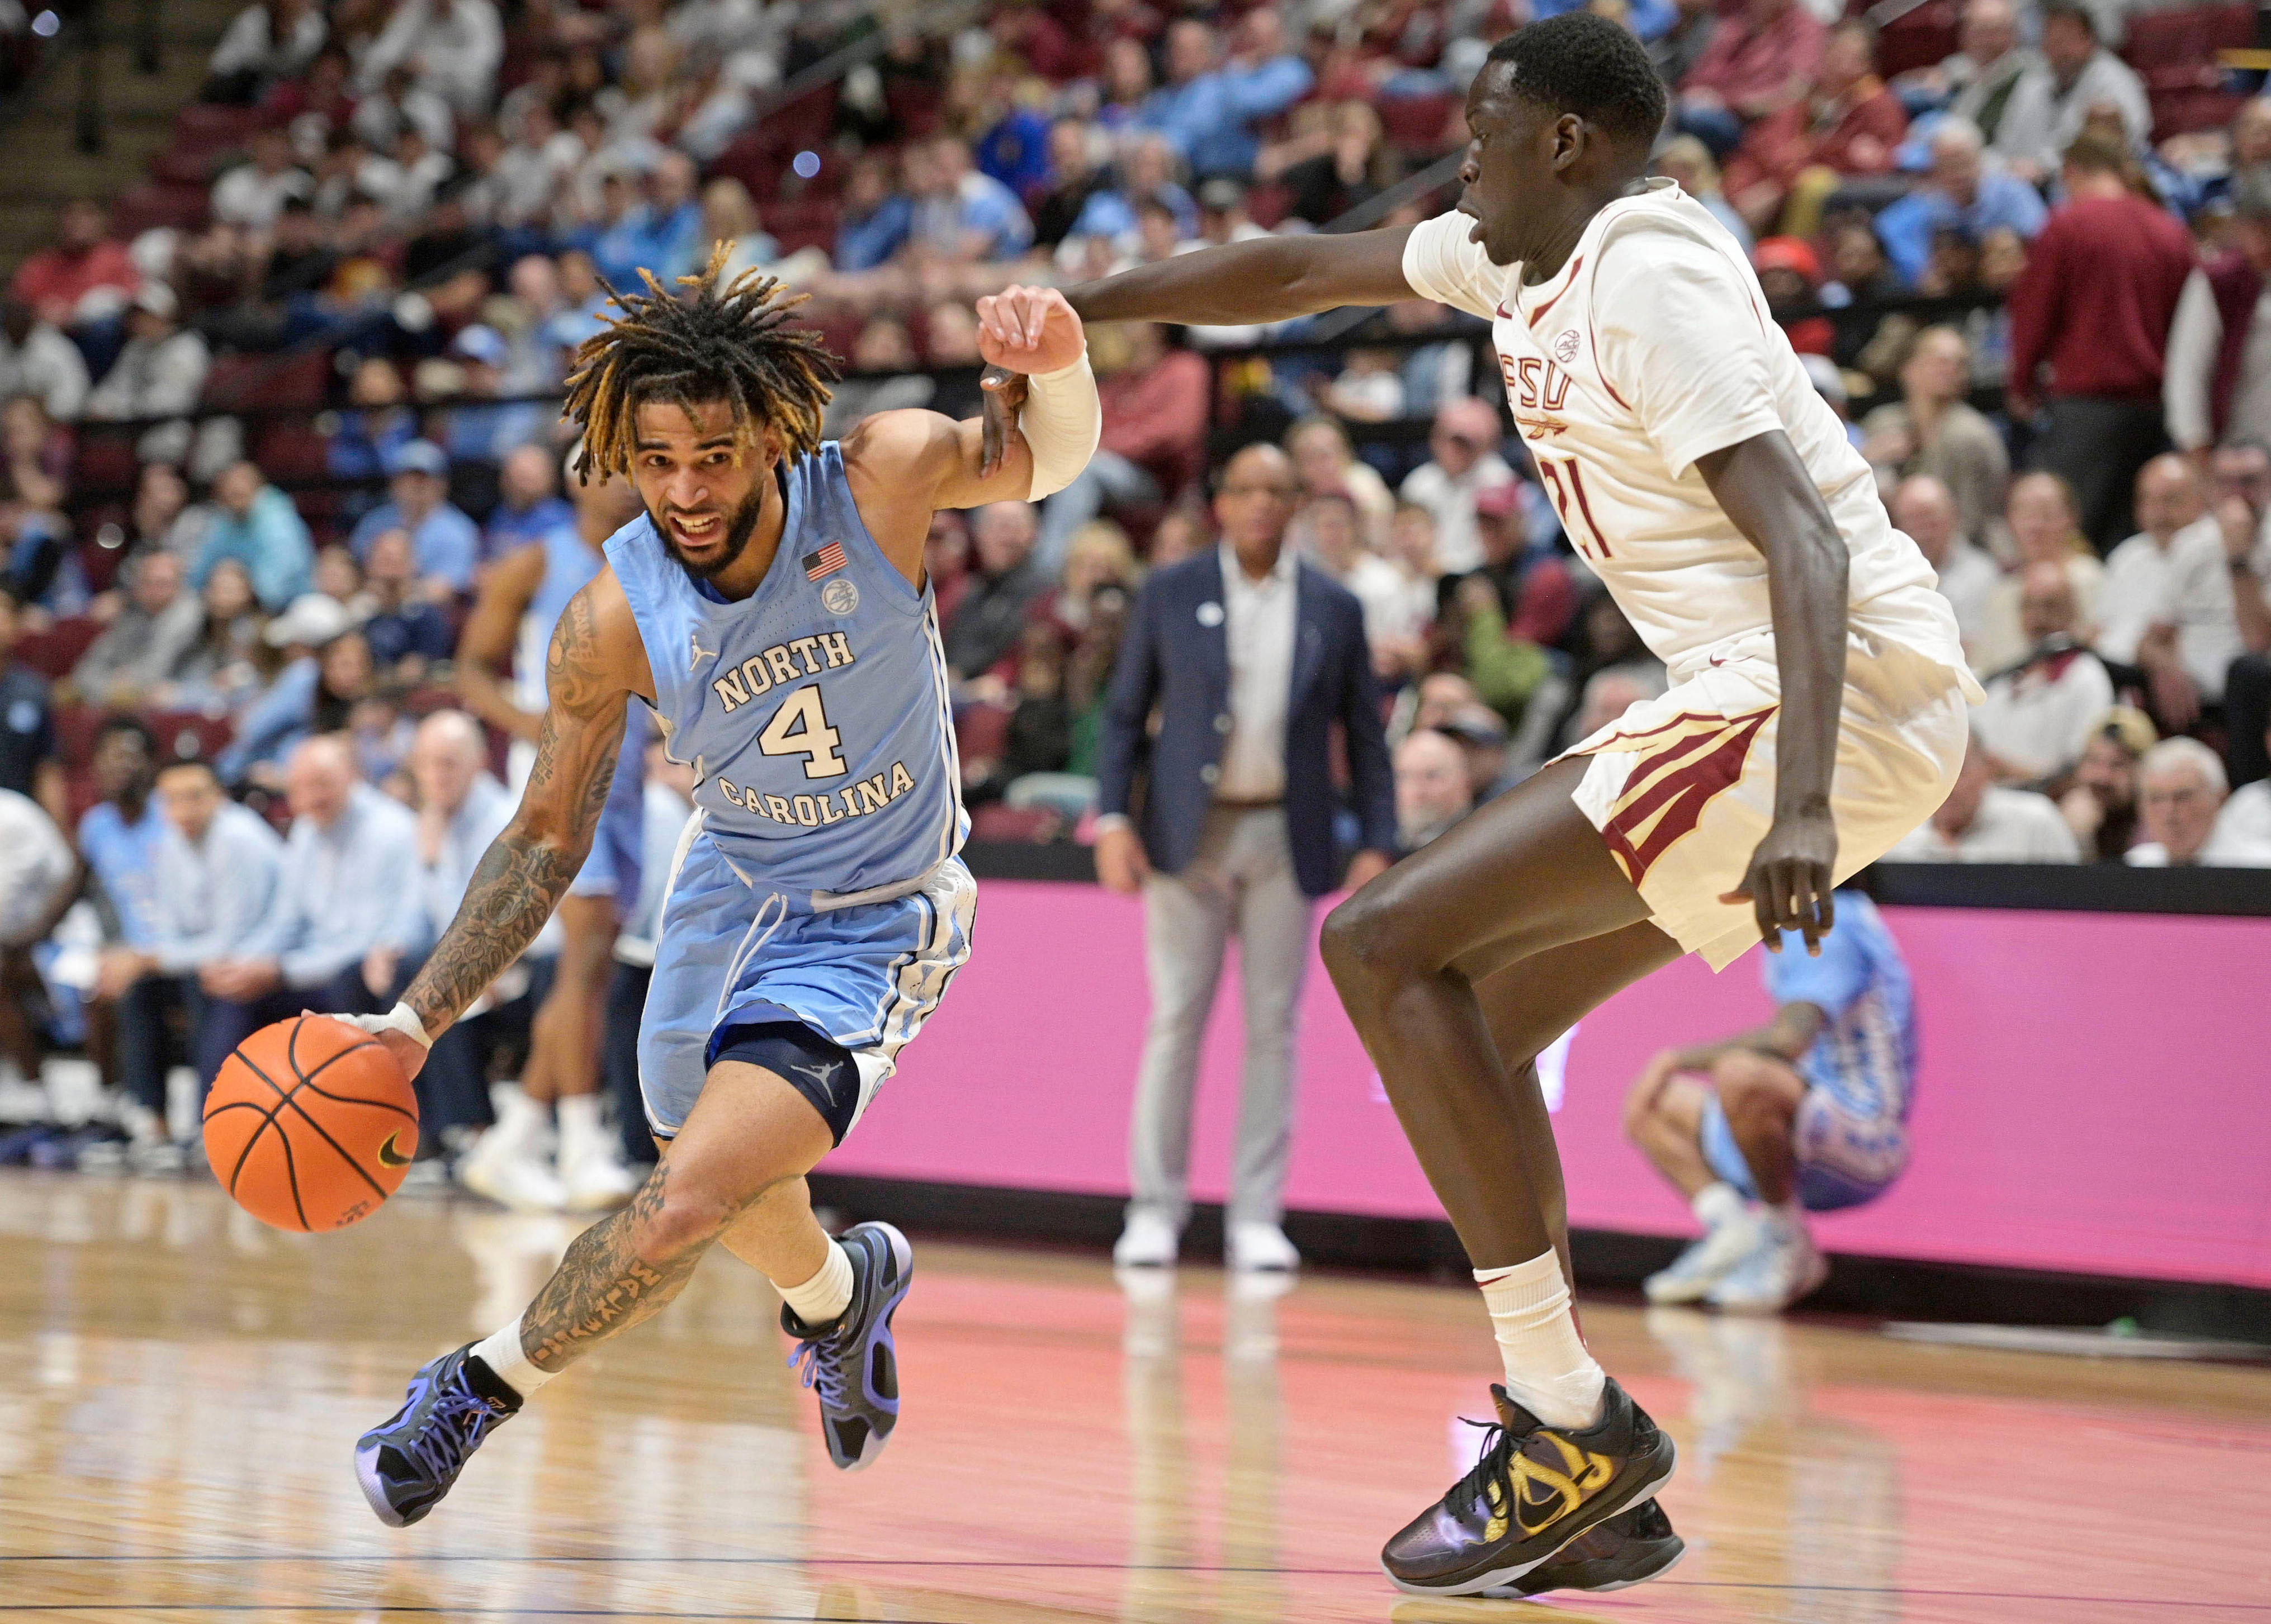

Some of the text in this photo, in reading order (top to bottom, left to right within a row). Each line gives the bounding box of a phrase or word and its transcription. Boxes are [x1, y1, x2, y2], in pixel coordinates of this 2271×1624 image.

[713, 631, 855, 713] NORTH
[756, 683, 849, 779] 4
[717, 761, 915, 827] CAROLINA
